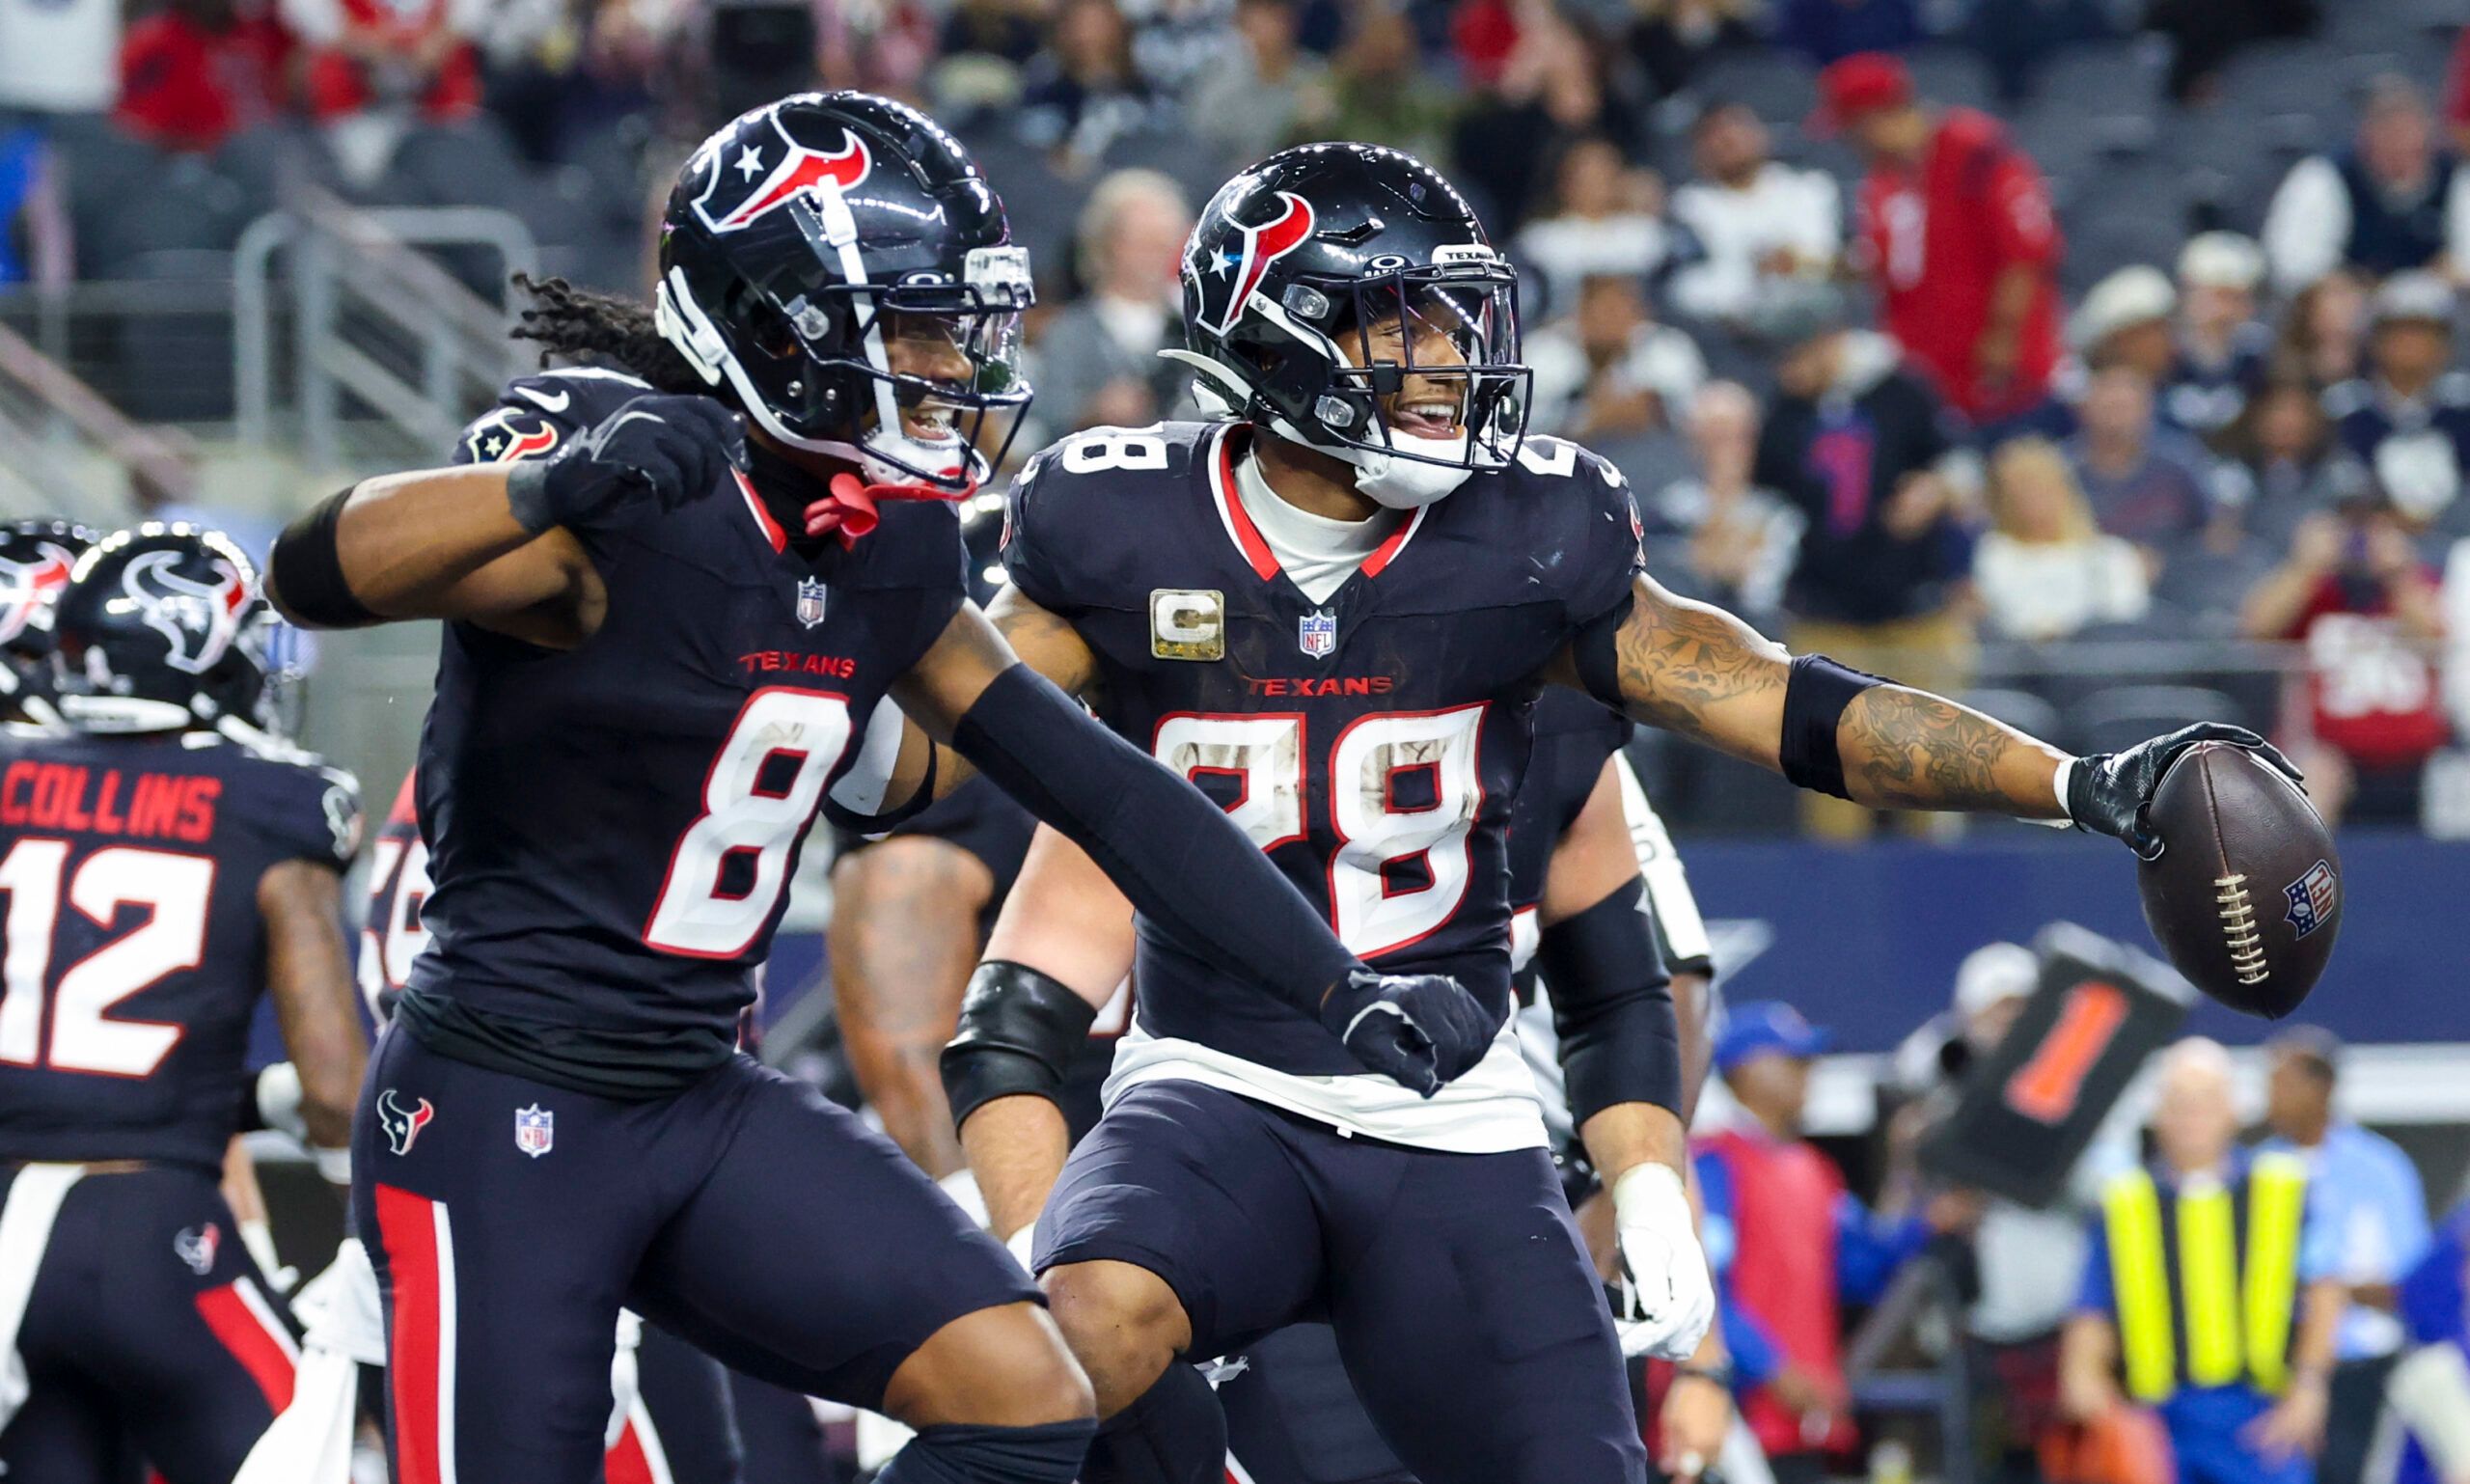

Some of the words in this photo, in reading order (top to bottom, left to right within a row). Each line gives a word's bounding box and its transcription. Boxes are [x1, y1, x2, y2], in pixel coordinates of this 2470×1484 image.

[1156, 594, 1219, 643] C
[1305, 633, 1331, 650] NFL
[738, 650, 857, 679] TEXANS
[1241, 675, 1394, 697] TEXANS
[0, 759, 223, 843] COLLINS
[641, 685, 853, 960] 8
[2309, 868, 2334, 921] NFL
[0, 835, 218, 1080] 12
